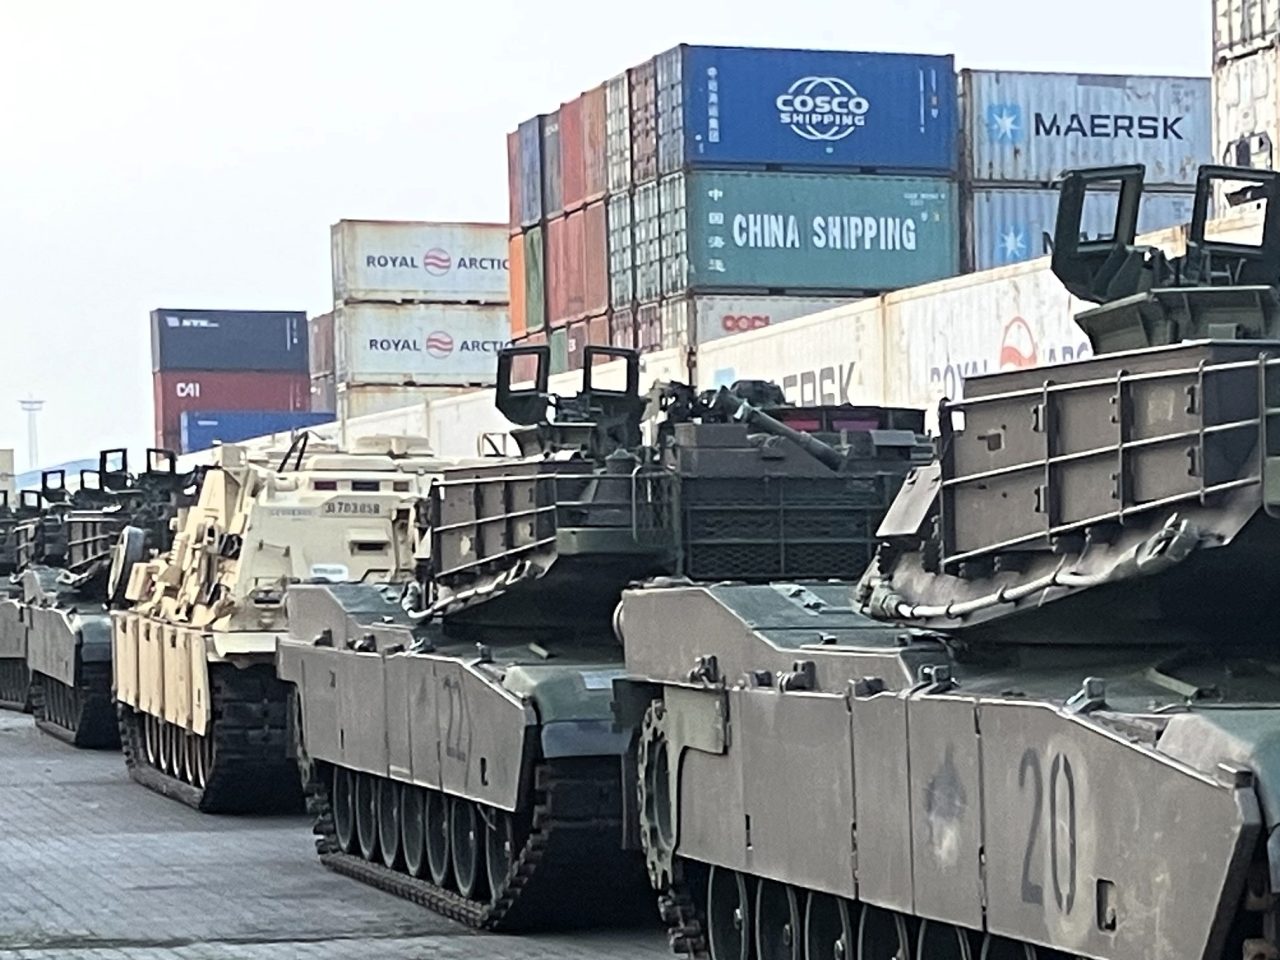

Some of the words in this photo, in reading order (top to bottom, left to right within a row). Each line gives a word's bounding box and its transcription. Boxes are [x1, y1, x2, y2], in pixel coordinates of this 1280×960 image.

[776, 95, 869, 114] COSCO
[780, 113, 865, 126] SHIPPING
[1035, 112, 1184, 140] MAERSK
[733, 214, 800, 249] CHINA
[812, 215, 916, 251] SHIPPING
[366, 255, 418, 268] ROYAL
[369, 339, 423, 351] ROYAL
[176, 383, 200, 397] CAI
[1018, 747, 1077, 916] 20
